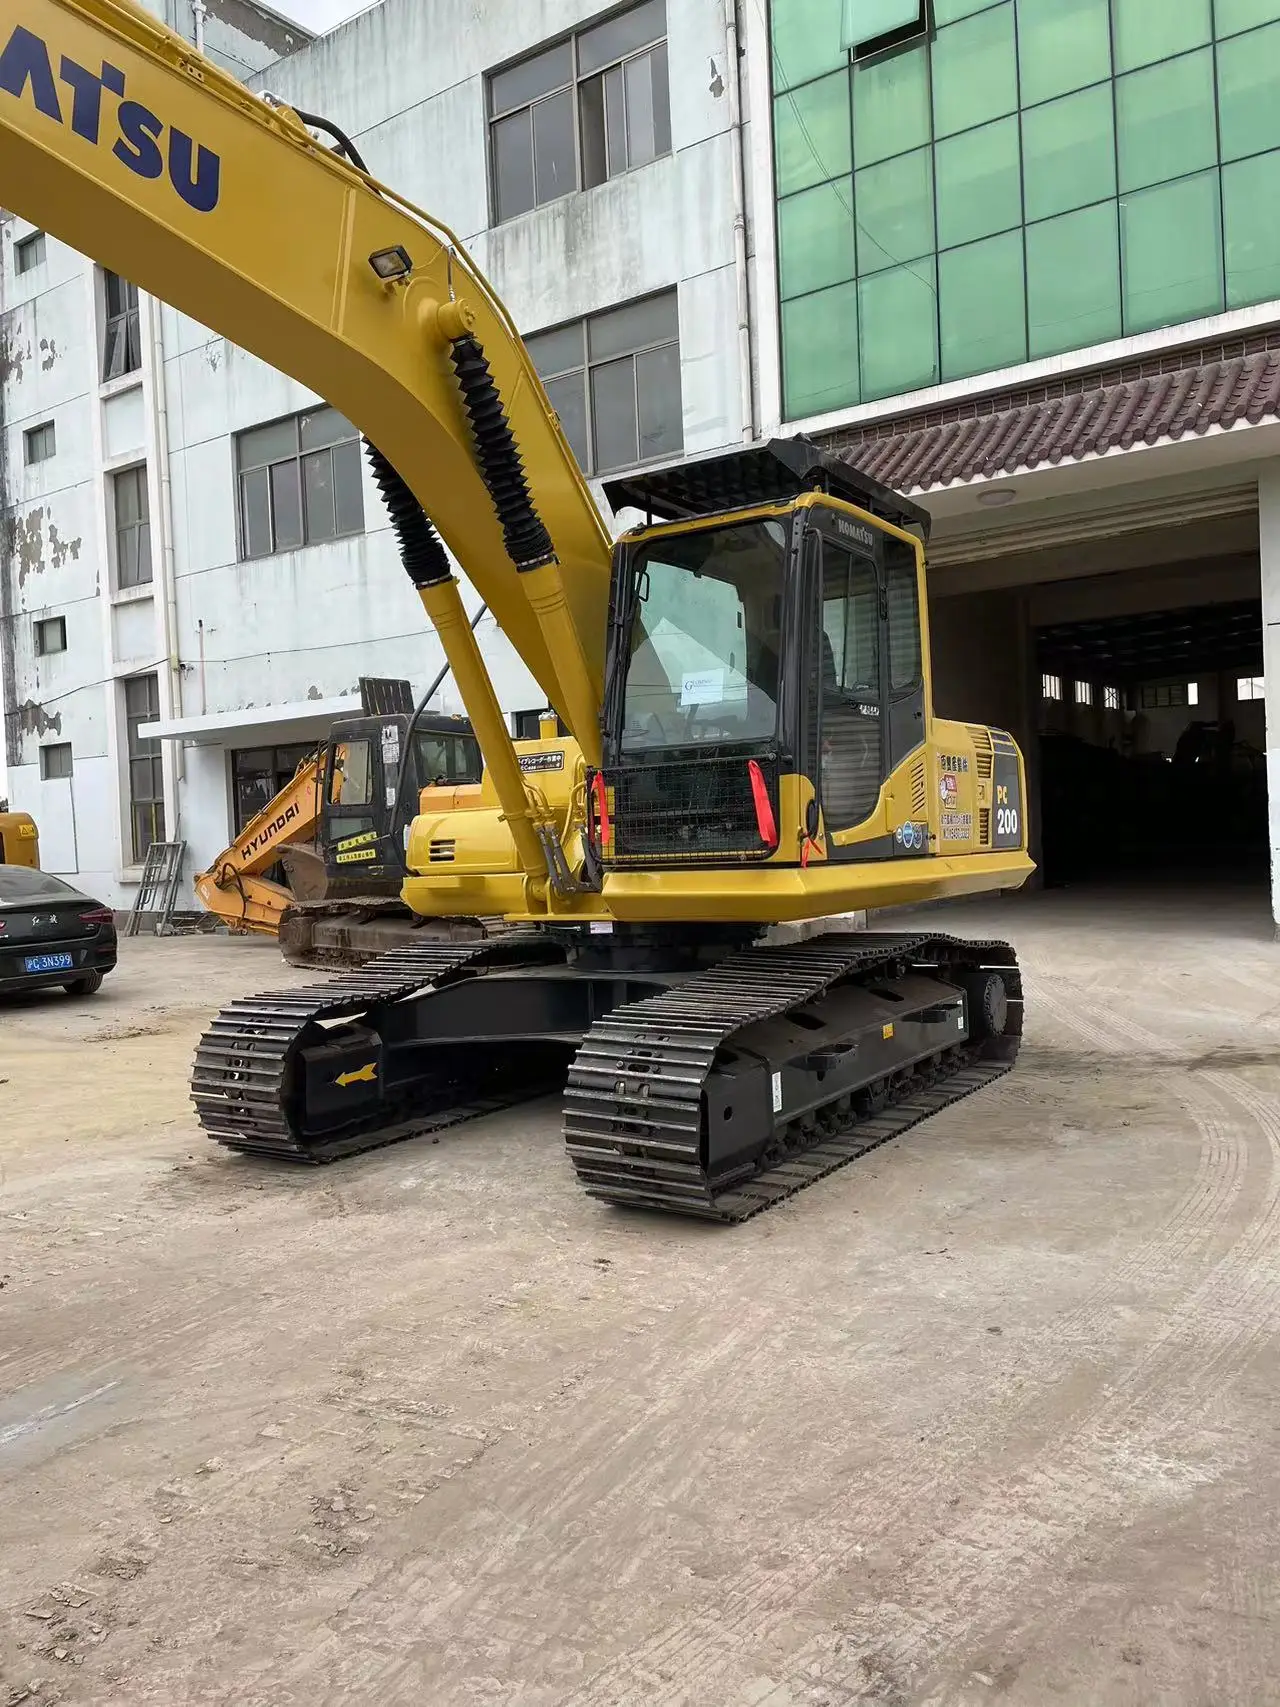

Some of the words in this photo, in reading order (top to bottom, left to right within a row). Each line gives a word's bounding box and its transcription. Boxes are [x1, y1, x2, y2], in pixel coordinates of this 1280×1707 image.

[0, 24, 220, 213] ATSU
[838, 518, 873, 546] KOMATSU
[997, 784, 1008, 805] PC
[241, 802, 300, 861] HYUNDAI
[997, 808, 1018, 835] 200
